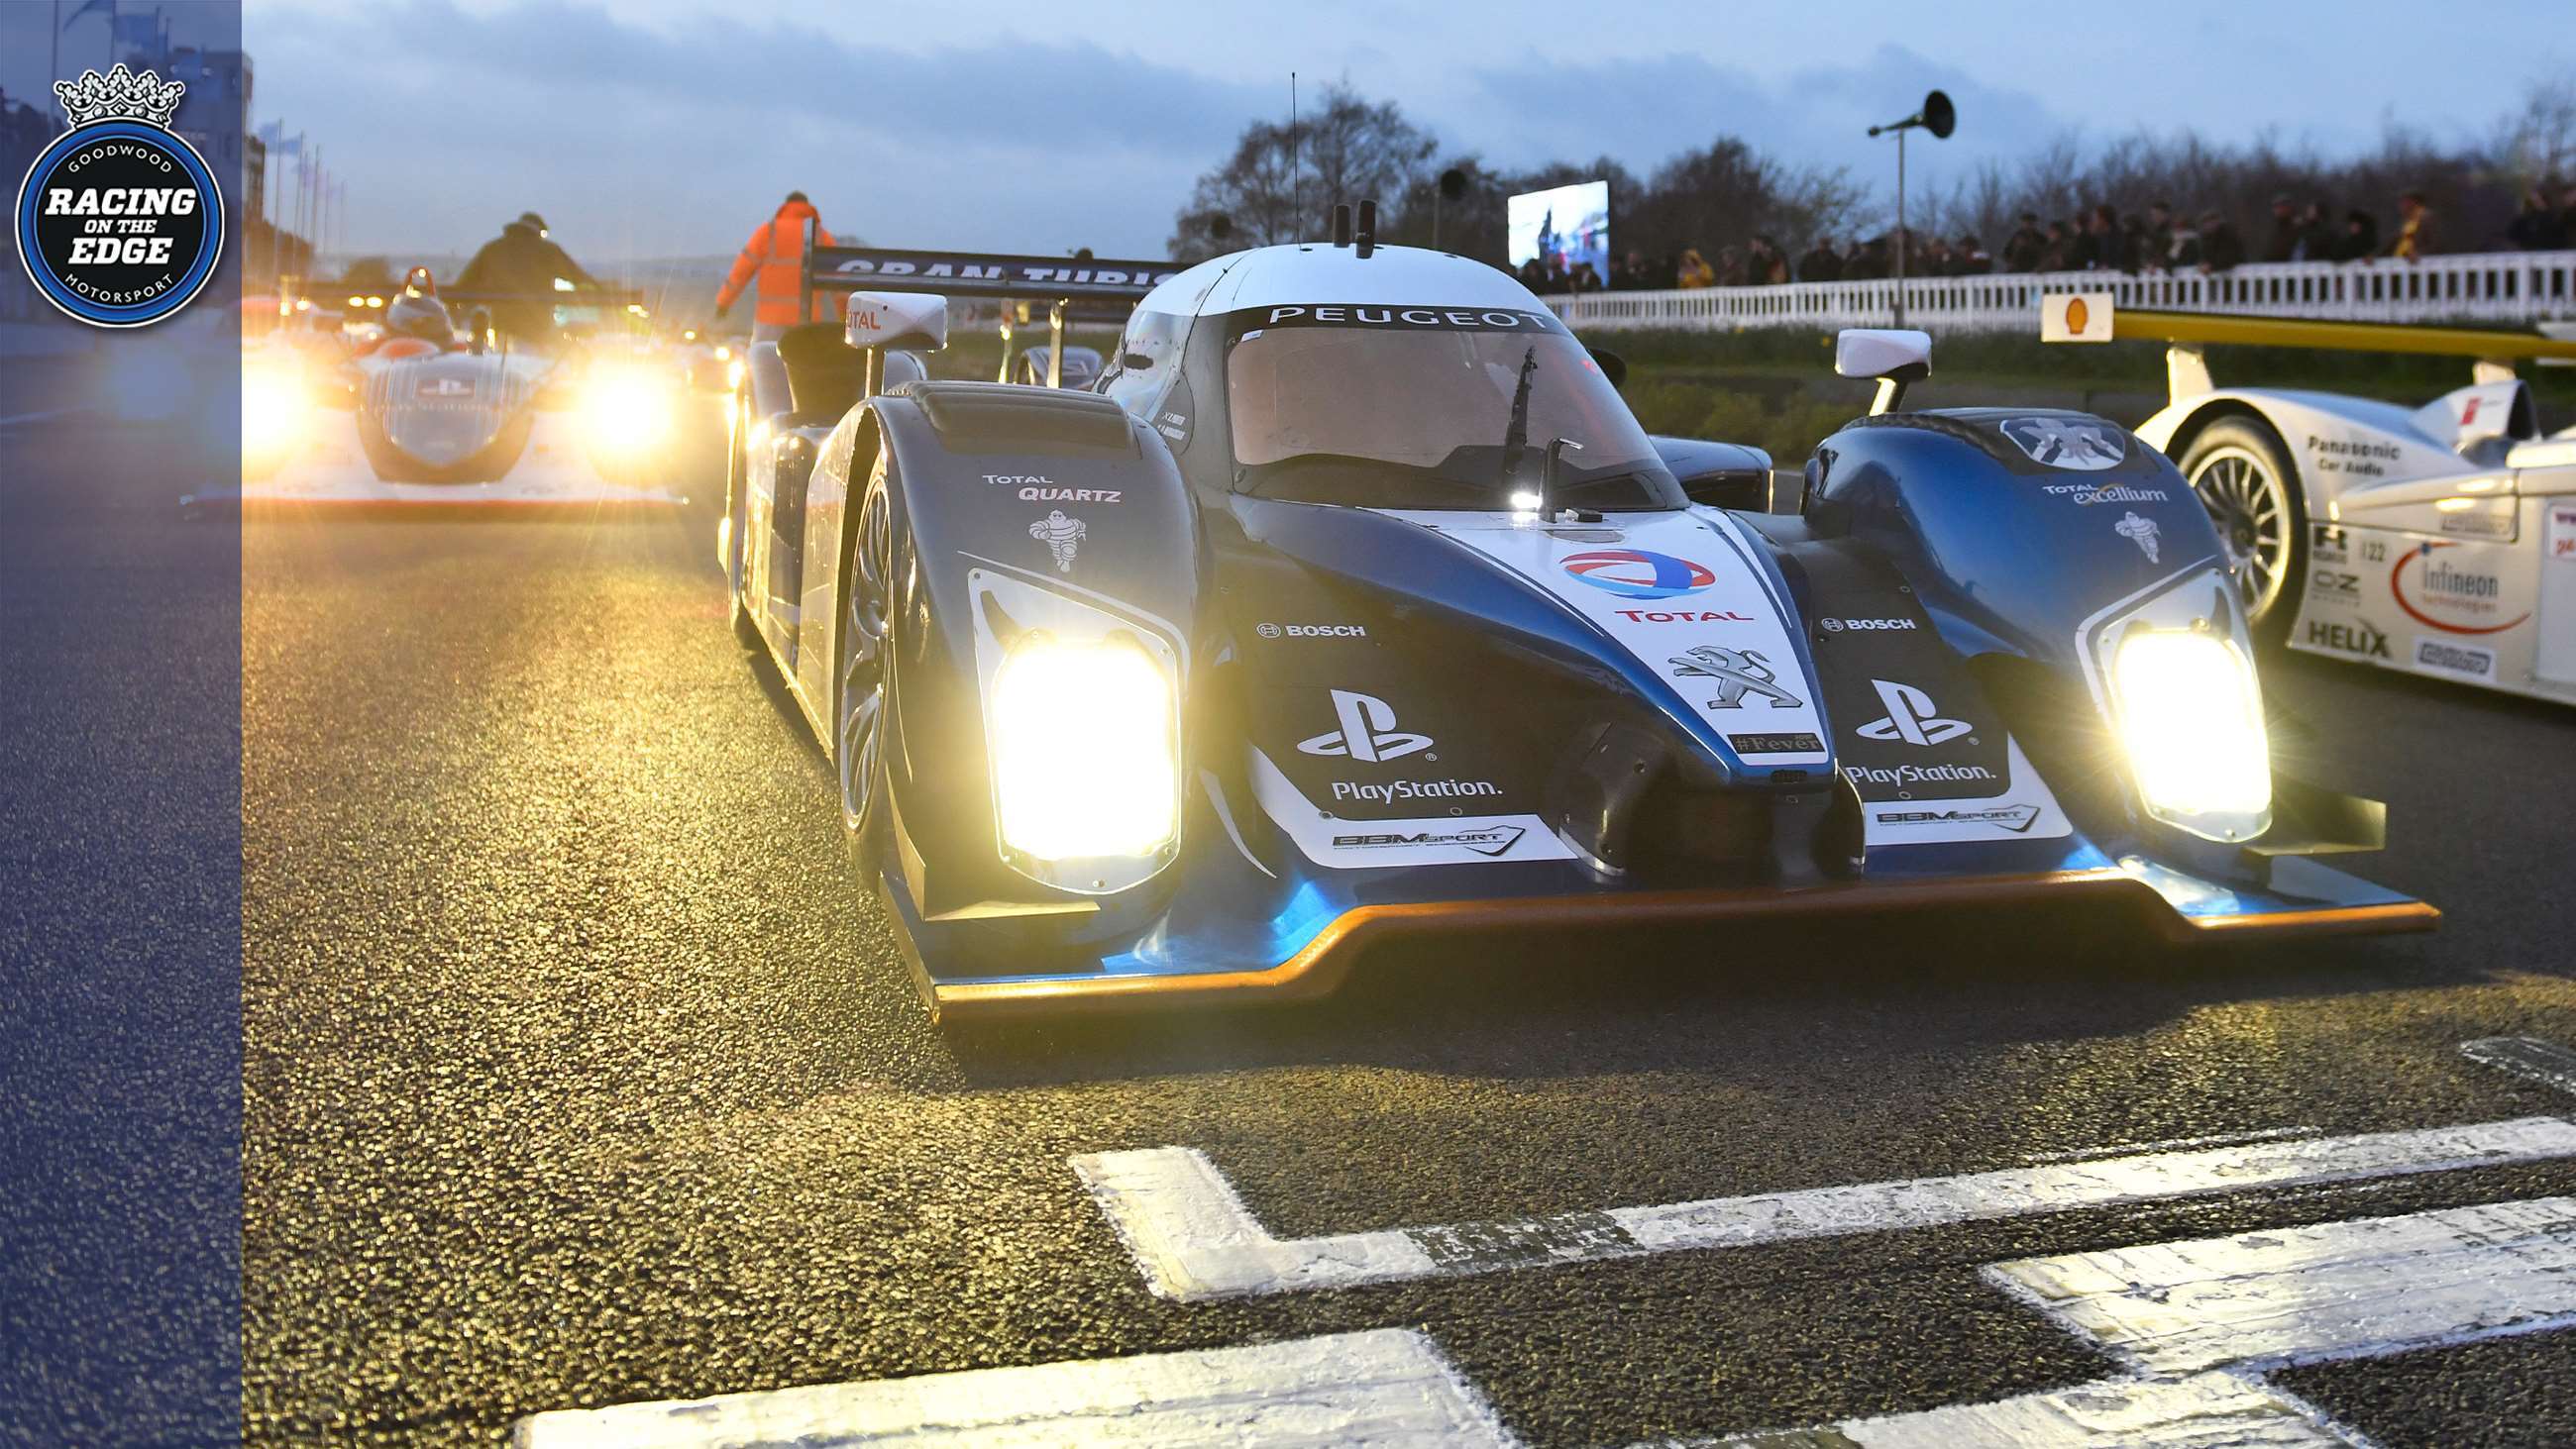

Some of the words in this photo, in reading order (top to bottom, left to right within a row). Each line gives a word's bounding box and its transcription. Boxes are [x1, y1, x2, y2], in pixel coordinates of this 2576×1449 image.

[845, 310, 881, 331] OTAL
[1270, 307, 1546, 329] PEUGEOT
[982, 474, 1054, 484] TOTAL
[1018, 487, 1122, 503] QUARTZ
[2074, 486, 2169, 505] excellium
[2423, 562, 2499, 597] Infineon
[1614, 610, 1755, 623] TOTAL
[1847, 618, 1917, 631] BOSCH
[1285, 625, 1366, 638] BOSCH
[2308, 618, 2390, 659] HELIX
